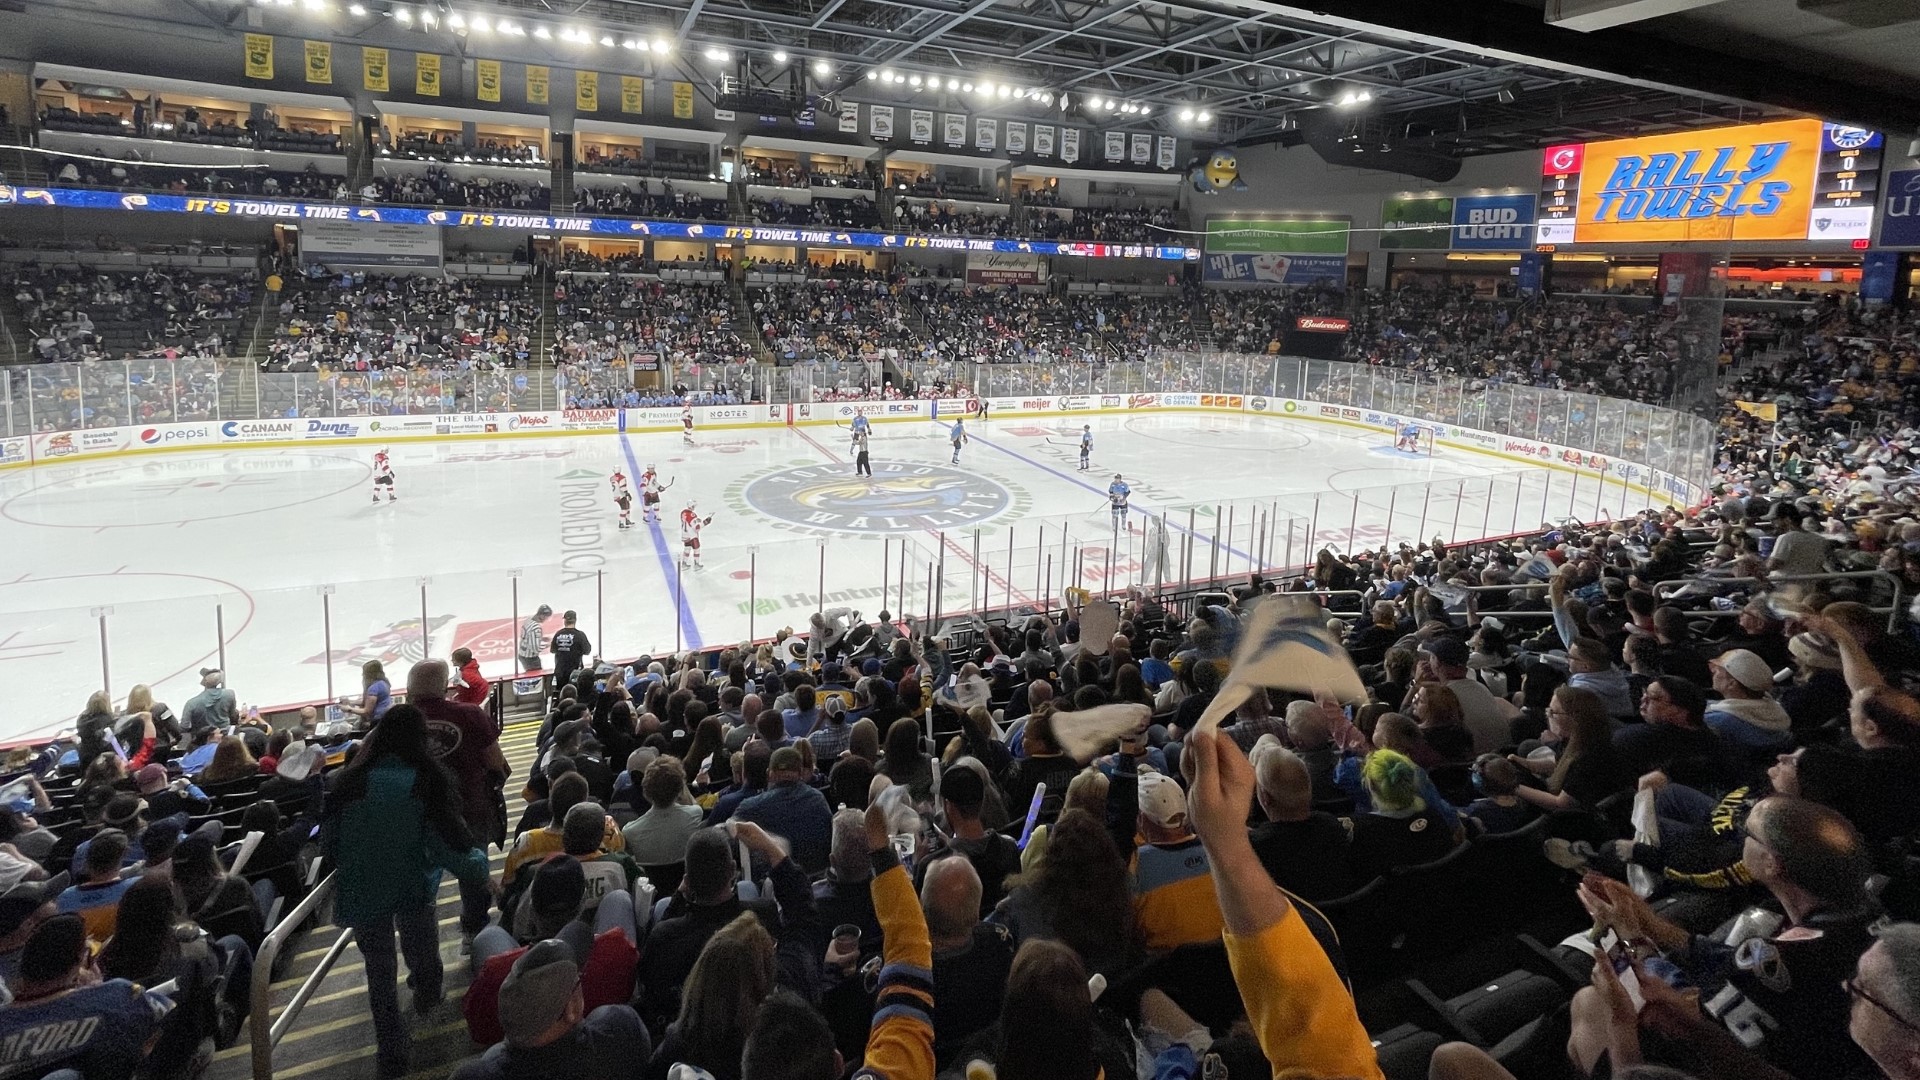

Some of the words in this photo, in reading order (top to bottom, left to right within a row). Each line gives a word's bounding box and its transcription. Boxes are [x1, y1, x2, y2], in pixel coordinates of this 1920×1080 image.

[1604, 141, 1792, 191] RALLY
[1844, 157, 1854, 170] 0
[1839, 179, 1853, 190] 11
[1593, 181, 1793, 221] TOWELS
[186, 199, 231, 214] IT'S
[234, 202, 300, 217] TOWEL
[304, 206, 350, 219] TIME
[1469, 208, 1518, 224] BUD
[460, 213, 495, 226] IT'S
[497, 215, 551, 229] TOWEL
[553, 218, 592, 230] TIME
[725, 227, 753, 239] IT'S
[755, 229, 798, 241] TOWEL
[800, 231, 831, 242] TIME
[1459, 225, 1523, 240] LIGHT
[904, 237, 929, 247] IT'S
[930, 238, 966, 249] TOWEL
[968, 240, 994, 250] TIME
[1210, 253, 1234, 270] HIT
[1222, 262, 1249, 279] ME!
[1300, 319, 1345, 330] Budweiser
[889, 404, 918, 412] BCSN
[1023, 399, 1051, 410] meijer
[464, 414, 498, 422] BLADE
[562, 409, 616, 418] BAUMANN
[165, 427, 208, 441] pepsi
[241, 423, 292, 433] CANAAN
[307, 420, 351, 434] Dunn
[1460, 430, 1496, 443] Huntington
[1505, 441, 1536, 456] Wendy's
[769, 464, 933, 483] TOLDO
[804, 491, 999, 529] WALLEYE
[560, 482, 609, 585] PROMEDICA
